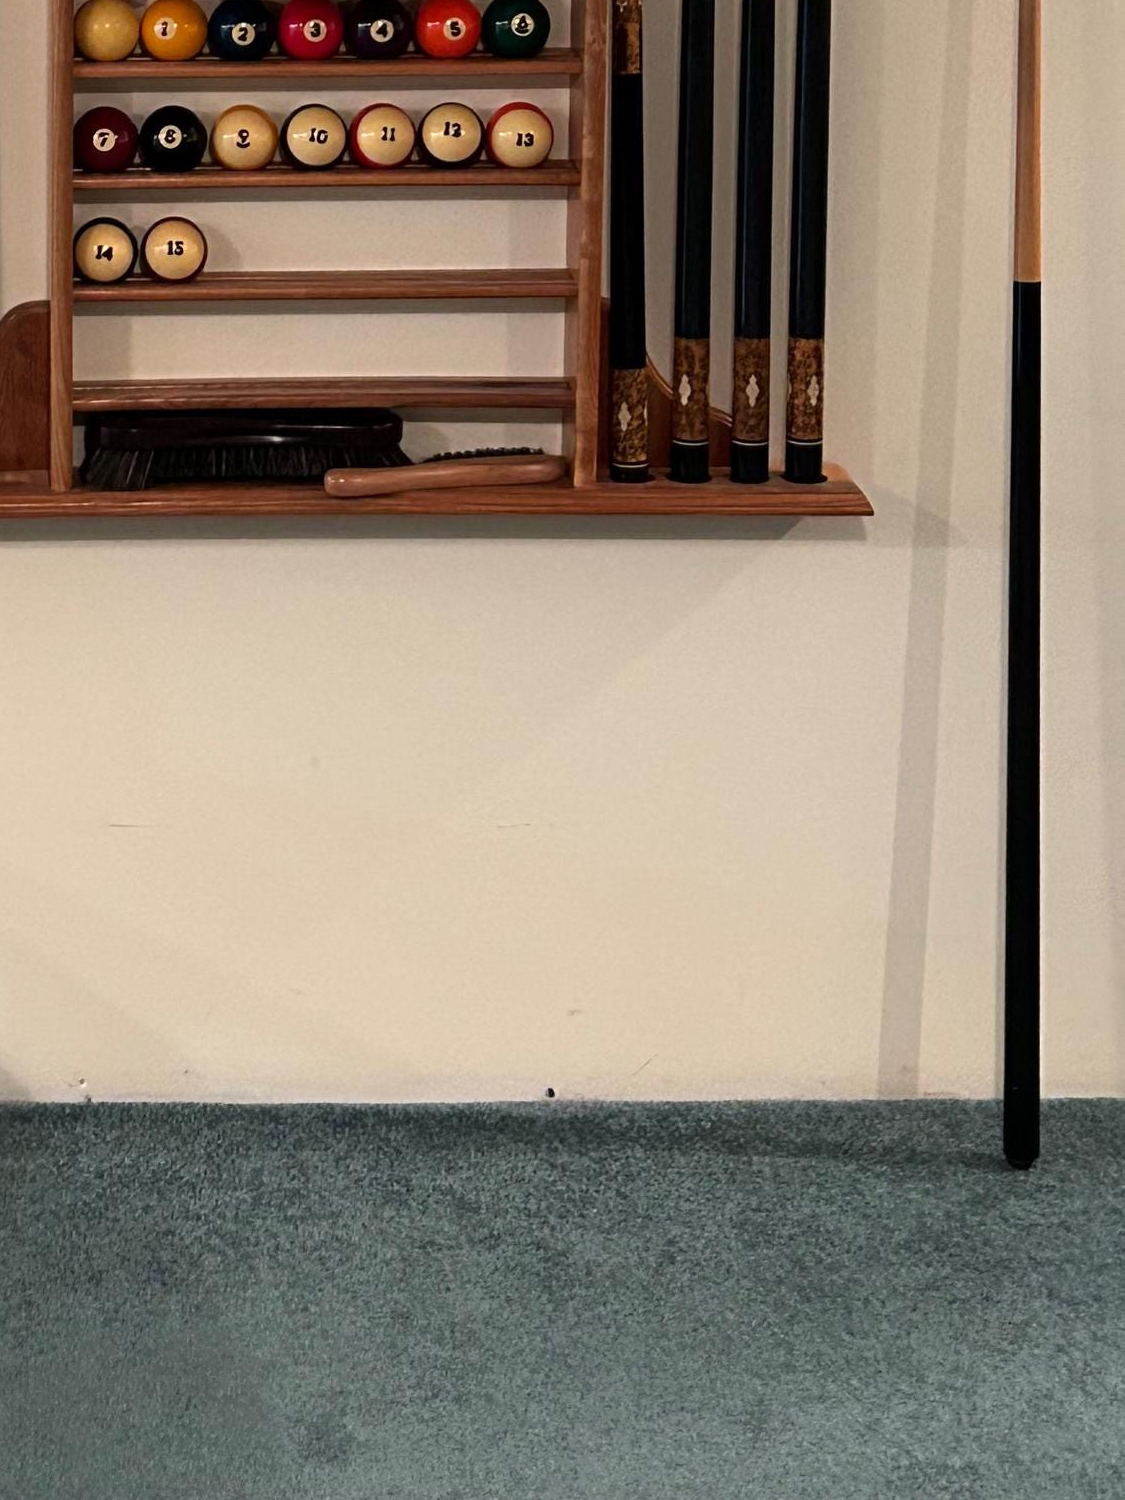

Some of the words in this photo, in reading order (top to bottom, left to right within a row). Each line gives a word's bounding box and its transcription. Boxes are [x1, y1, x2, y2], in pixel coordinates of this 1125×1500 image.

[161, 21, 169, 37] 1
[238, 27, 249, 42] 2
[310, 22, 321, 38] 3
[376, 21, 388, 36] 4
[449, 20, 461, 36] 5
[164, 129, 176, 144] 8
[308, 127, 329, 144] 10
[381, 126, 396, 142] 11
[443, 121, 462, 138] 12
[97, 132, 110, 148] 7
[516, 132, 535, 147] 13
[95, 244, 114, 261] 14
[167, 240, 184, 256] 15
